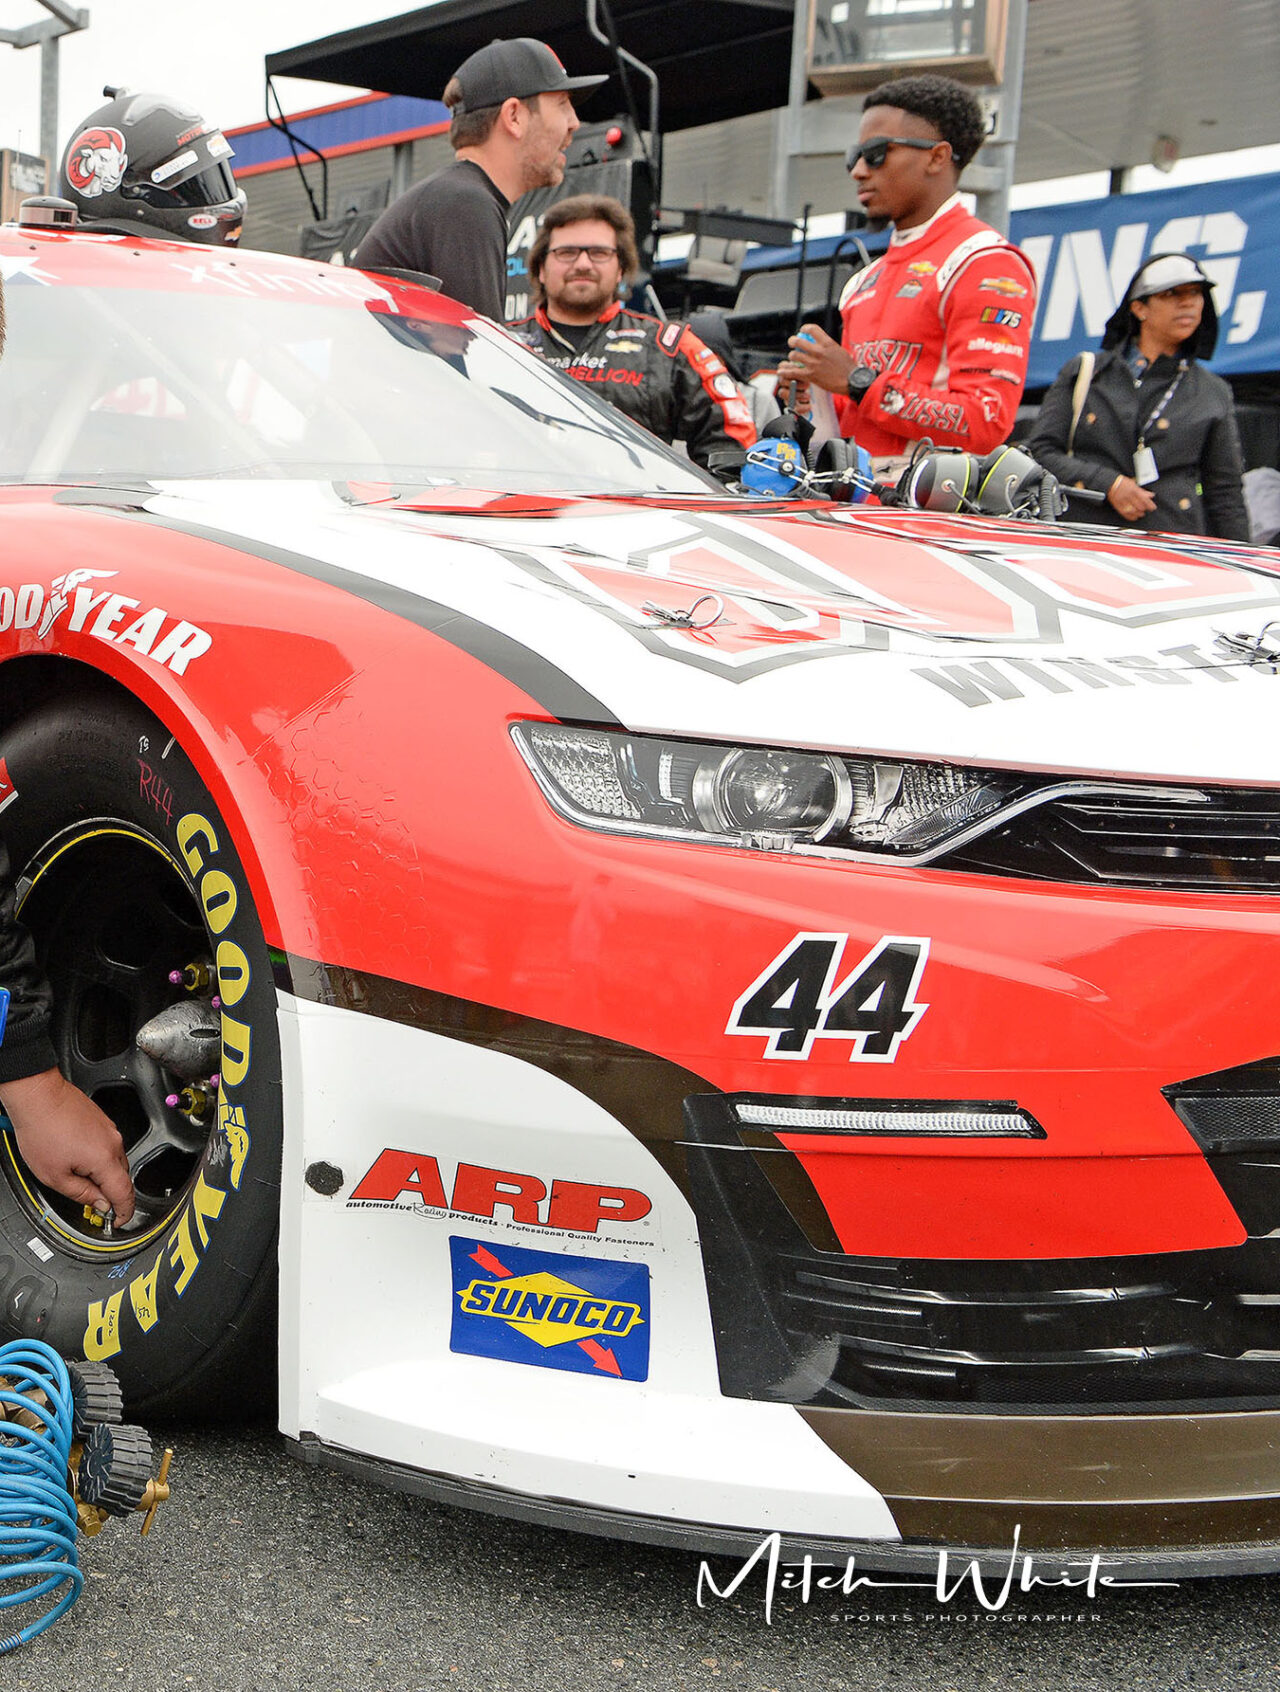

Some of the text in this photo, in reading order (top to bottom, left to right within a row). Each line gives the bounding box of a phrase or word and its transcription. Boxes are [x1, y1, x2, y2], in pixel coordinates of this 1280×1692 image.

[170, 263, 399, 313] xfinity
[1001, 310, 1022, 328] 75
[724, 931, 932, 1064] 44
[348, 1147, 653, 1233] ARP
[345, 1200, 413, 1212] automotive
[448, 1211, 499, 1226] products
[506, 1223, 565, 1238] Professional
[567, 1232, 603, 1243] Quality
[605, 1236, 655, 1247] Fasteners
[468, 1281, 636, 1335] SUNOCO
